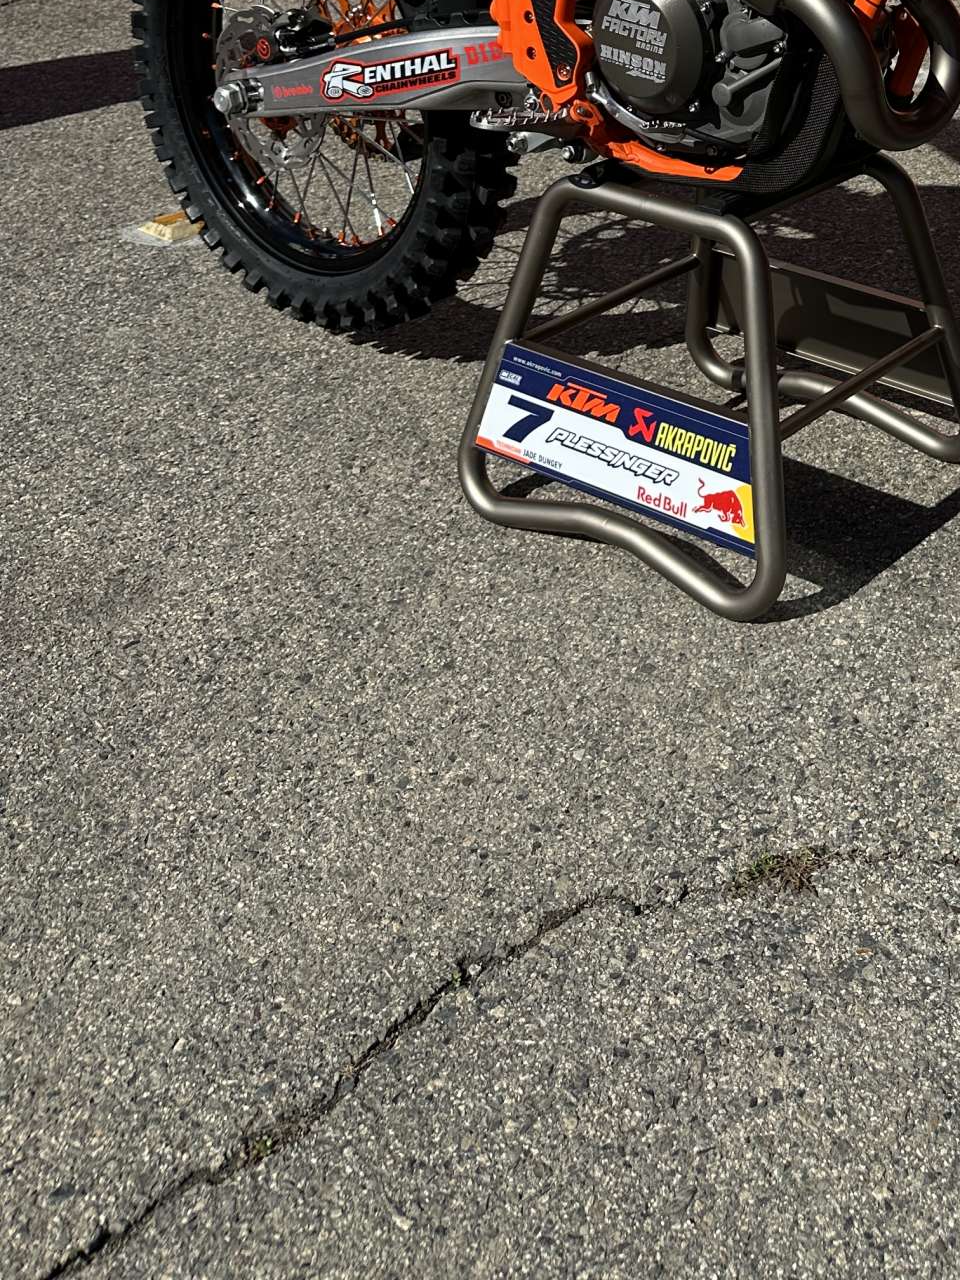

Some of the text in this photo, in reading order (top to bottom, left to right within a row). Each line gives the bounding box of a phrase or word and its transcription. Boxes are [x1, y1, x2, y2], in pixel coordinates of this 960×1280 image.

[602, 15, 667, 47] FACTORY
[464, 41, 503, 66] DID
[601, 44, 667, 75] HINSON
[324, 52, 457, 98] RENTHAL
[375, 71, 457, 93] CHAINWHEELS
[502, 394, 555, 443] 7
[546, 382, 737, 472] KTM AKRAPOVIČ
[523, 448, 537, 460] JADE
[545, 427, 680, 486] PLESSINGER
[637, 486, 688, 519] Red Bull
